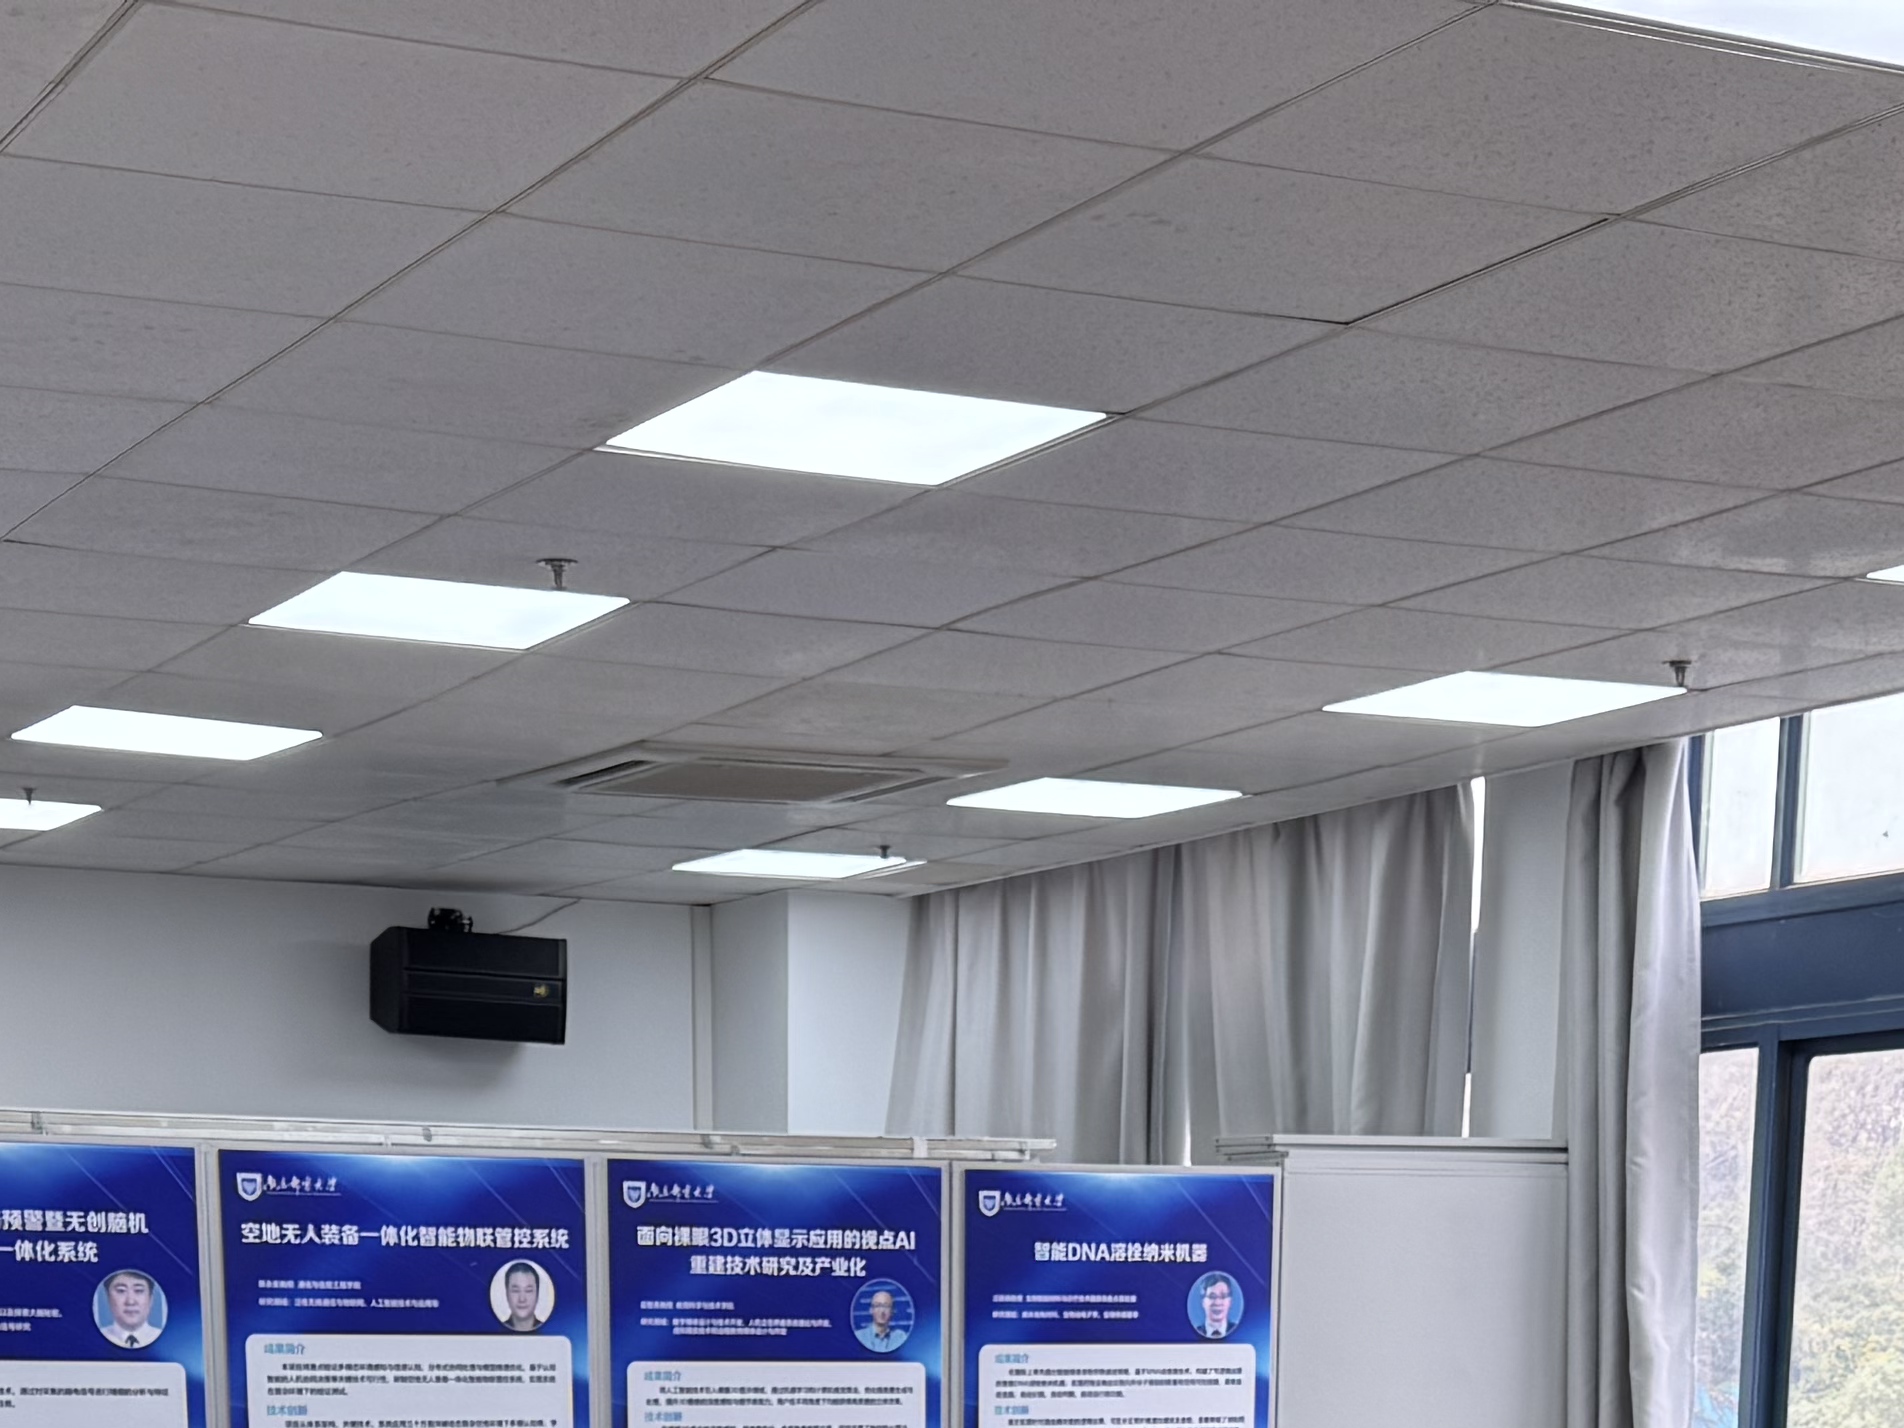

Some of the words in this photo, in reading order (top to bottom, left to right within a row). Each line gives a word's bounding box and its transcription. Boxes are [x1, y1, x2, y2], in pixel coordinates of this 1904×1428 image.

[240, 1223, 570, 1250] 空地无人装备一体化智能物联管控系统
[636, 1225, 917, 1251] 面向裸眼3D立体显示应用的视点AI
[1034, 1241, 1208, 1264] 智能DNA溶栓纳米机器
[689, 1255, 867, 1278] 重建技术研究及产业化
[266, 1405, 308, 1417] 技术创新
